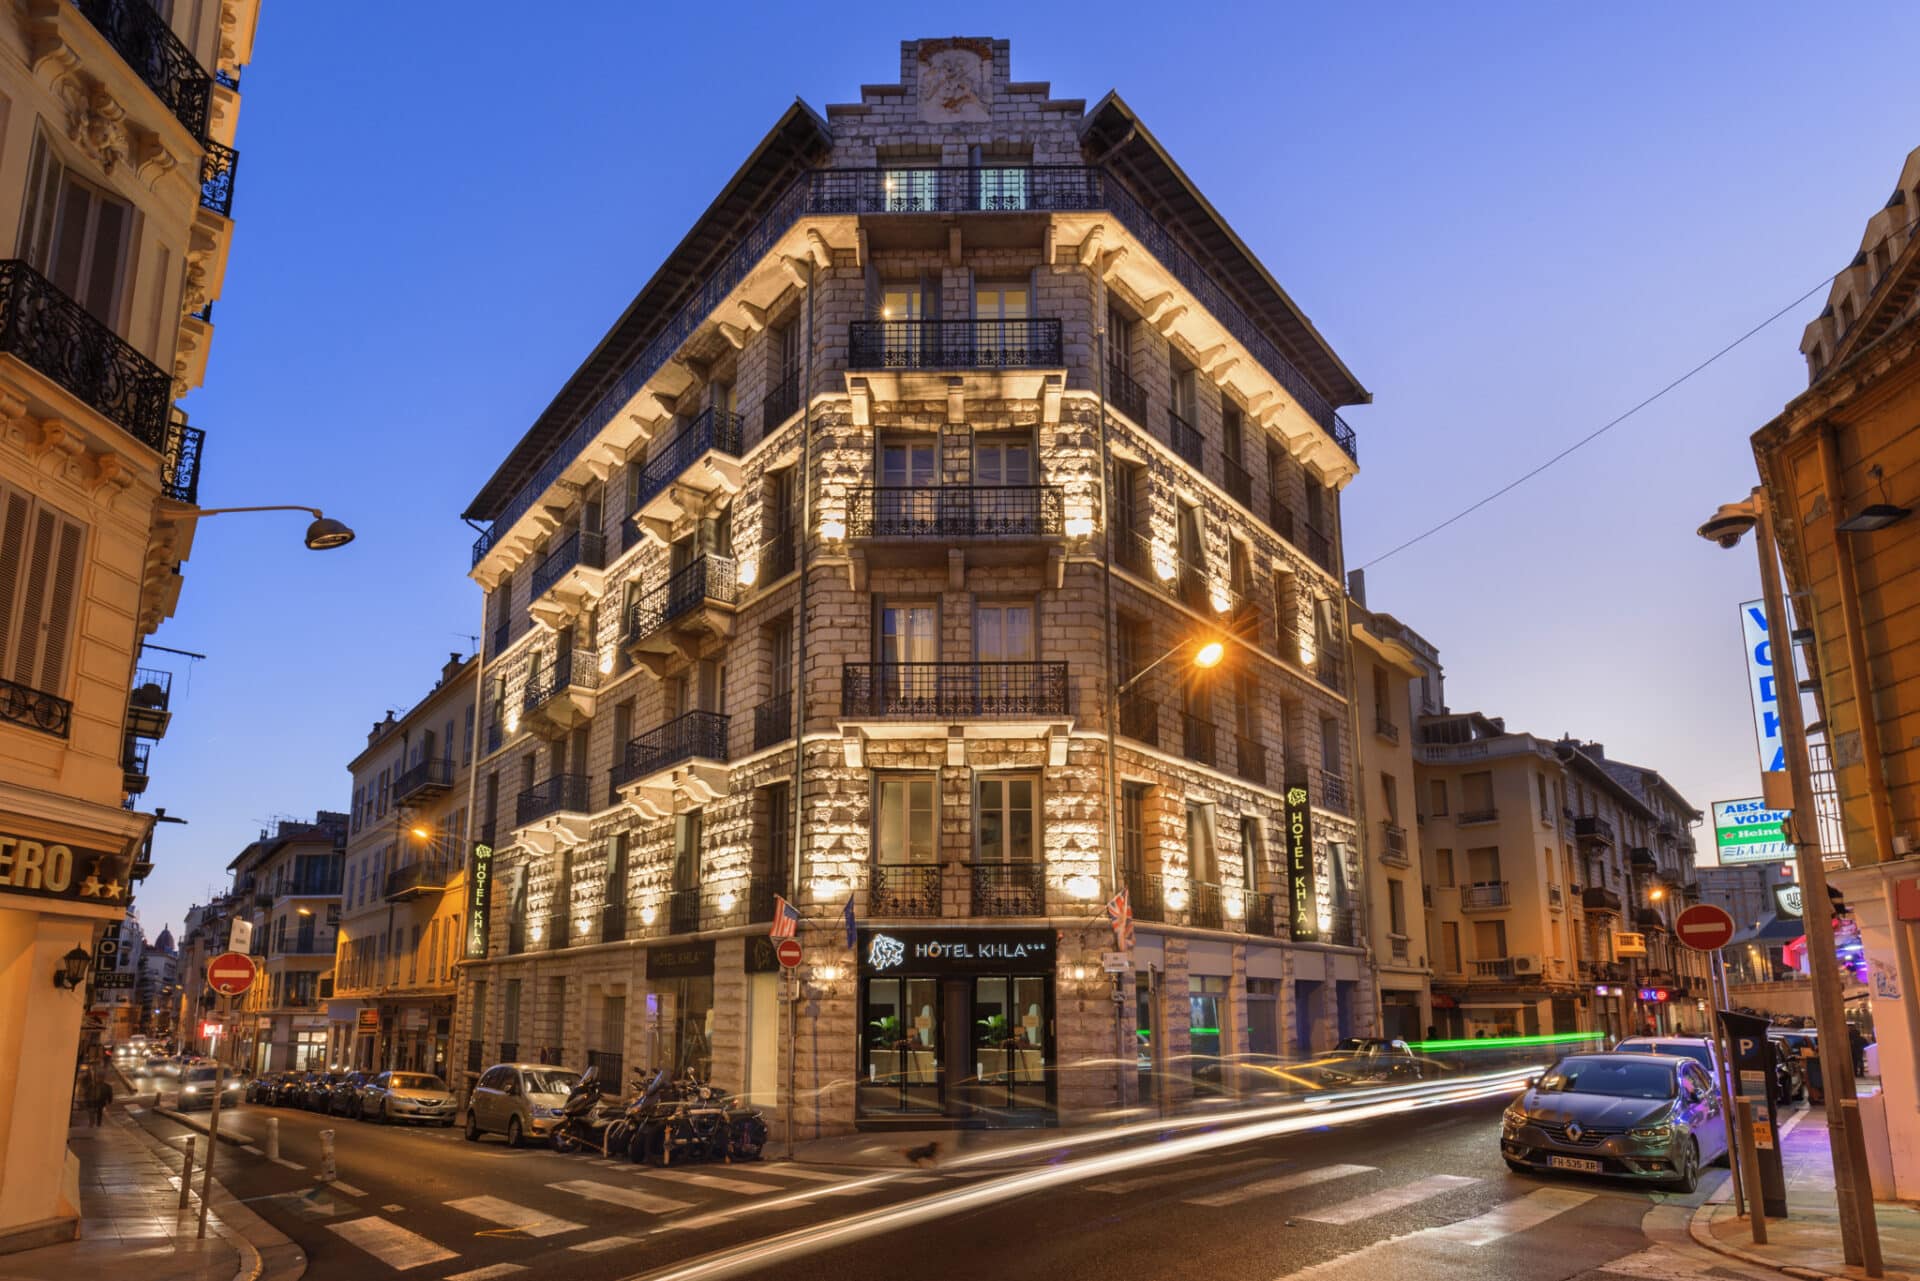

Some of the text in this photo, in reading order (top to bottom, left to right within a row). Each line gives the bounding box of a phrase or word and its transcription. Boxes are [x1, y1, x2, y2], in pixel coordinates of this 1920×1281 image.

[1736, 843, 1796, 856] БАЛТИ
[1292, 812, 1308, 923] HOTEL KHLA
[472, 863, 486, 945] HOTEL KHLA
[916, 941, 1027, 958] HÔTEL KHLA
[1740, 1039, 1754, 1056] P
